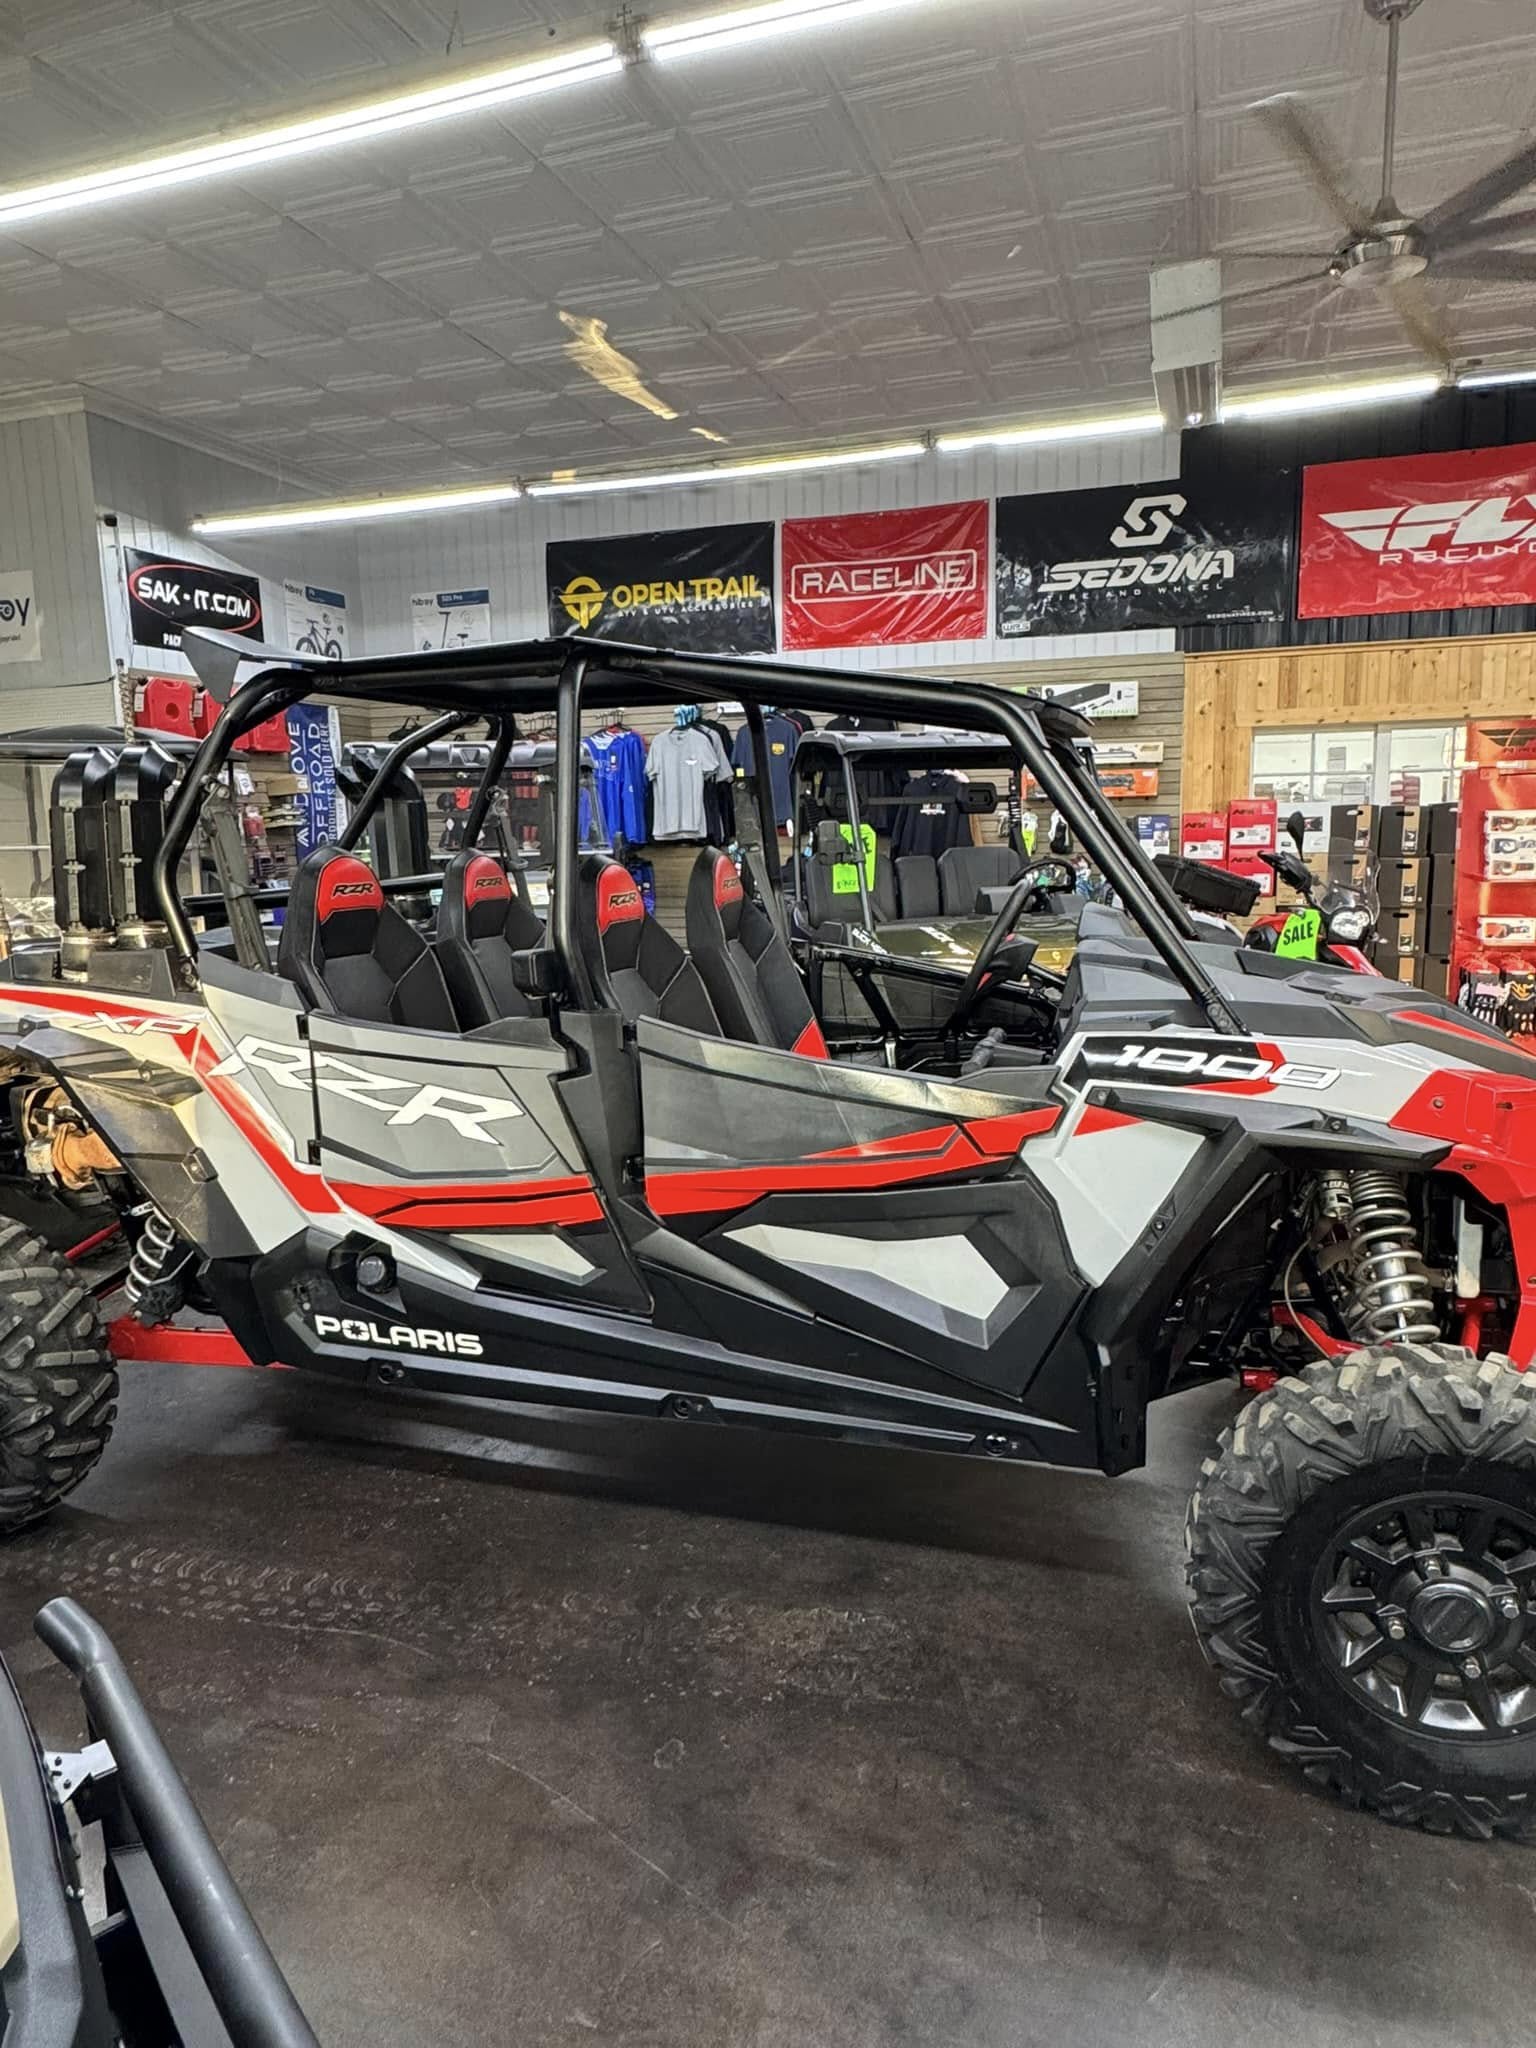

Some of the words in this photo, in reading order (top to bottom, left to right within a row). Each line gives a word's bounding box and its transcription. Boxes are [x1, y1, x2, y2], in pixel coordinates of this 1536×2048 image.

[802, 560, 966, 594] RACELINE
[1037, 549, 1234, 592] SEDONA
[138, 577, 180, 606] SAK
[194, 588, 251, 618] IT.COM
[612, 580, 685, 608] OPEN
[688, 575, 765, 602] TRAIL
[1106, 588, 1142, 598] AND
[1158, 583, 1223, 594] WHEEL
[321, 755, 336, 785] SOLD
[326, 787, 339, 843] RODUCTS
[333, 883, 374, 897] RZR
[475, 877, 503, 889] RZR
[1283, 921, 1314, 946] SALE
[72, 1011, 199, 1037] XP
[1114, 1044, 1342, 1090] 1000
[207, 1034, 527, 1147] RZR
[314, 1314, 484, 1356] POLARIS
